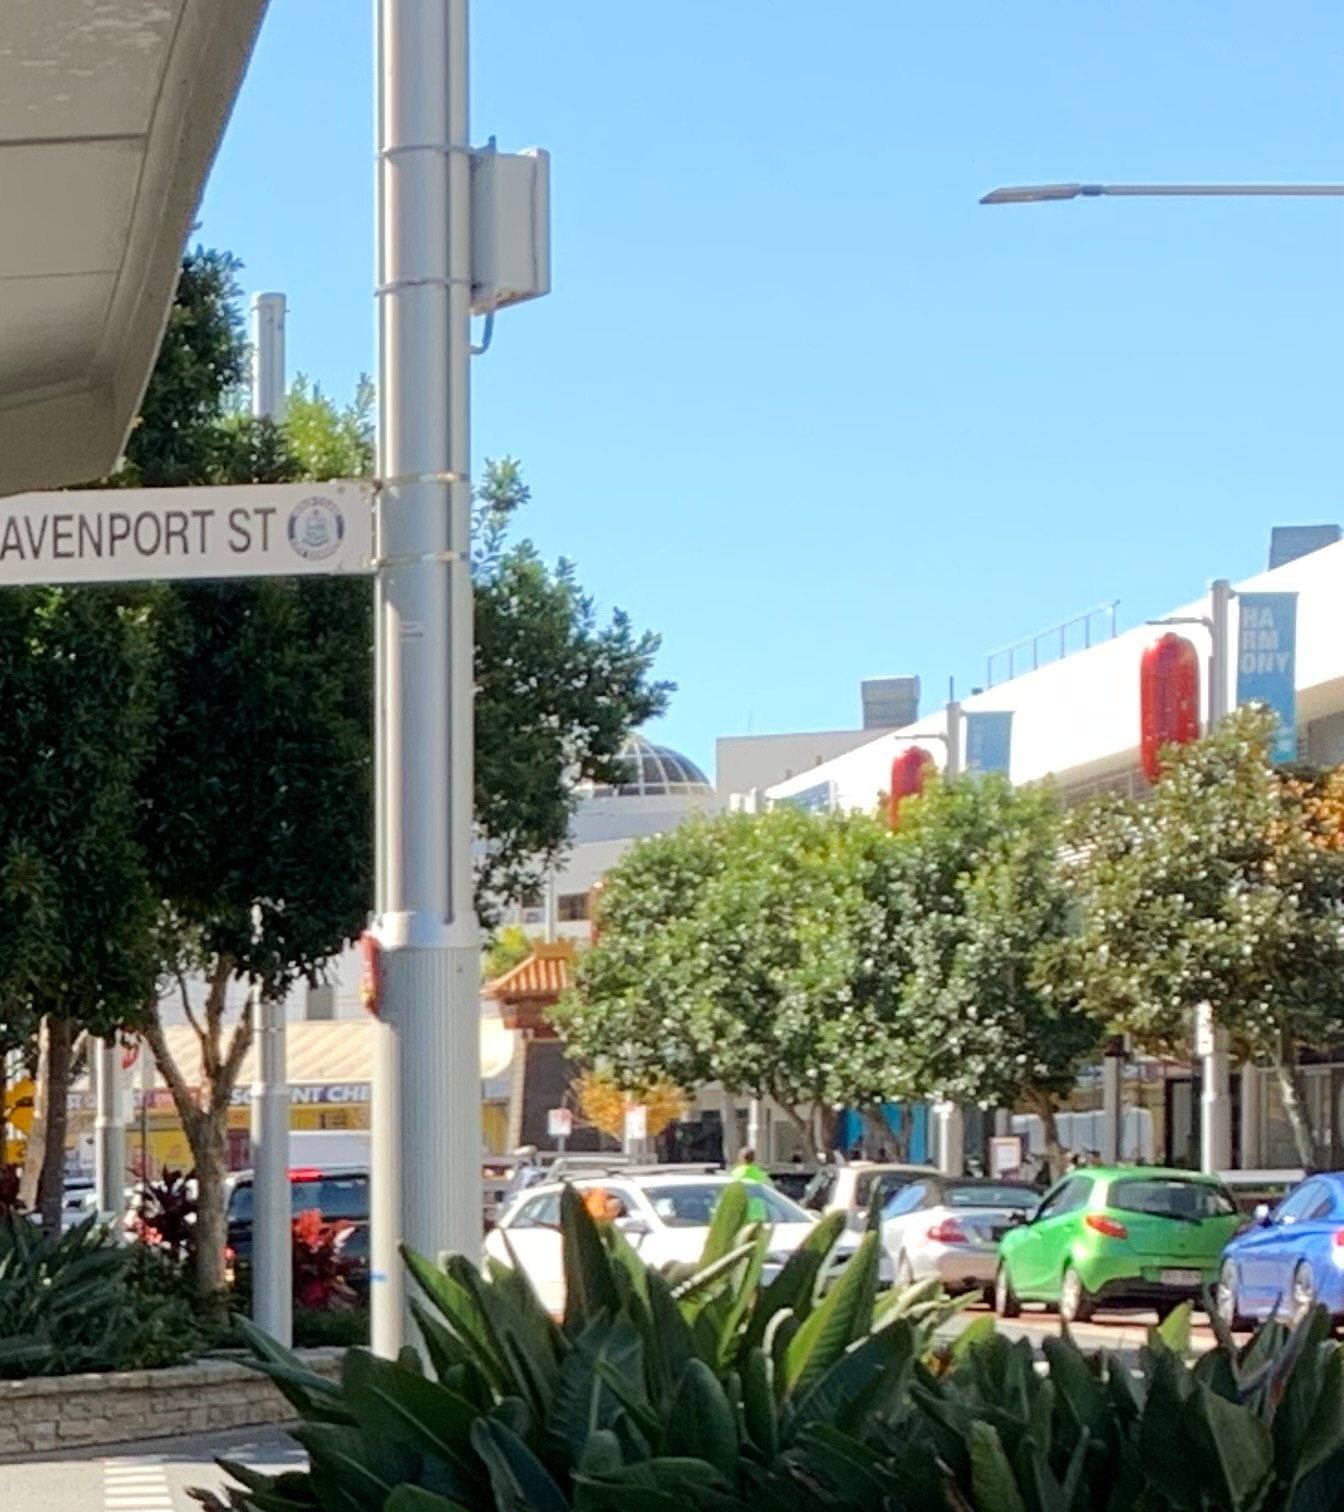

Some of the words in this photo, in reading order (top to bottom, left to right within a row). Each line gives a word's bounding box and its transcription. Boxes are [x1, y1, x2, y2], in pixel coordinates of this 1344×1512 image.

[227, 507, 277, 554] ST
[1243, 606, 1275, 629] HA
[1242, 629, 1280, 650] RM
[1240, 651, 1290, 674] ONY
